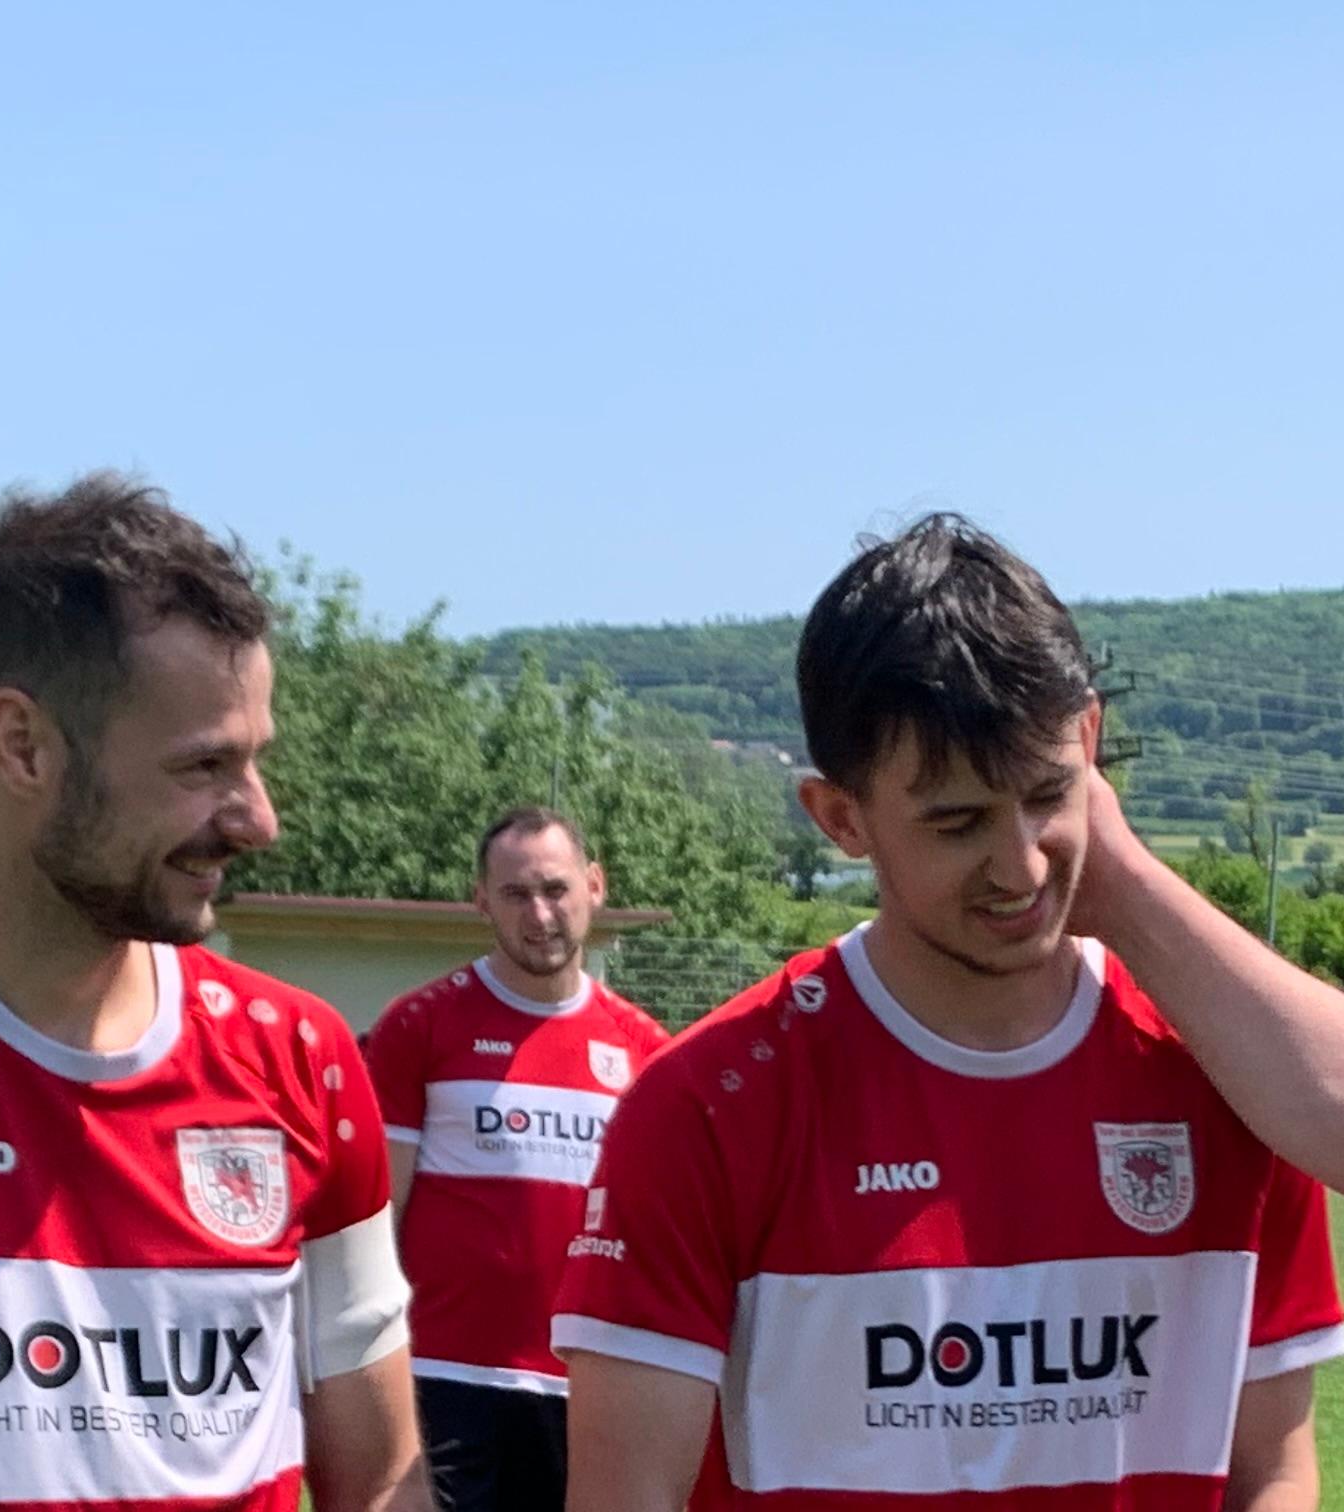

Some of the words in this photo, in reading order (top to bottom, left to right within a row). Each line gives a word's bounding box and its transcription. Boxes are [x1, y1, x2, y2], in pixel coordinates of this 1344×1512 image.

[473, 1039, 514, 1056] JAKO
[855, 1160, 940, 1194] JAKO
[864, 1314, 1159, 1389] DOTLUX
[37, 1406, 60, 1432] IN
[71, 1406, 162, 1439] BESTER
[170, 1403, 258, 1442] QUALIT
[866, 1402, 935, 1428] LICHT
[969, 1398, 1058, 1427] BESTER
